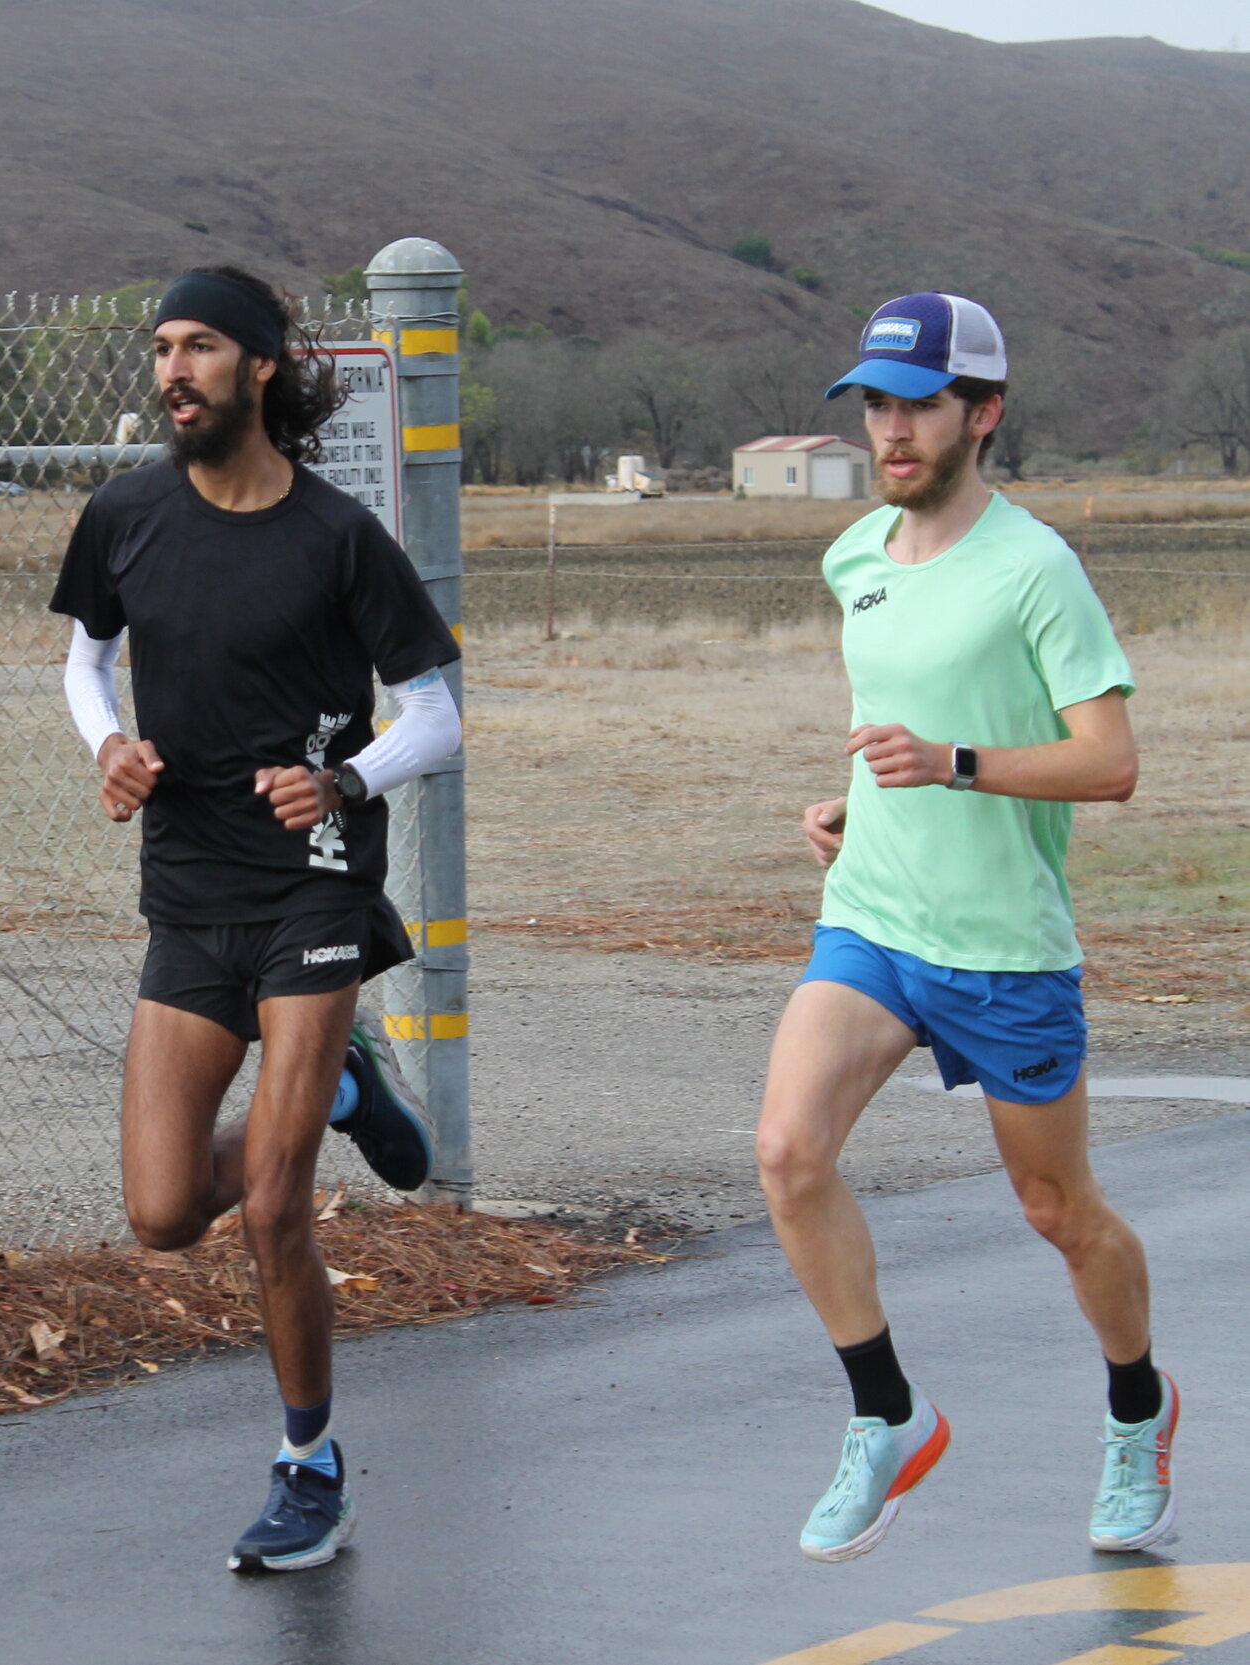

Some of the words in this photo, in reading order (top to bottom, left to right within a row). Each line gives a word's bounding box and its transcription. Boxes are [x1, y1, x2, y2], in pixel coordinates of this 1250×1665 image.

[867, 333, 912, 345] AGGIES
[351, 421, 375, 438] WHILE
[353, 445, 362, 461] AT
[365, 444, 382, 461] THIS
[329, 468, 362, 485] FACILITY
[374, 490, 385, 507] BE
[852, 586, 887, 616] HOKA
[302, 945, 347, 965] HOKA
[1013, 1057, 1058, 1083] HOKA
